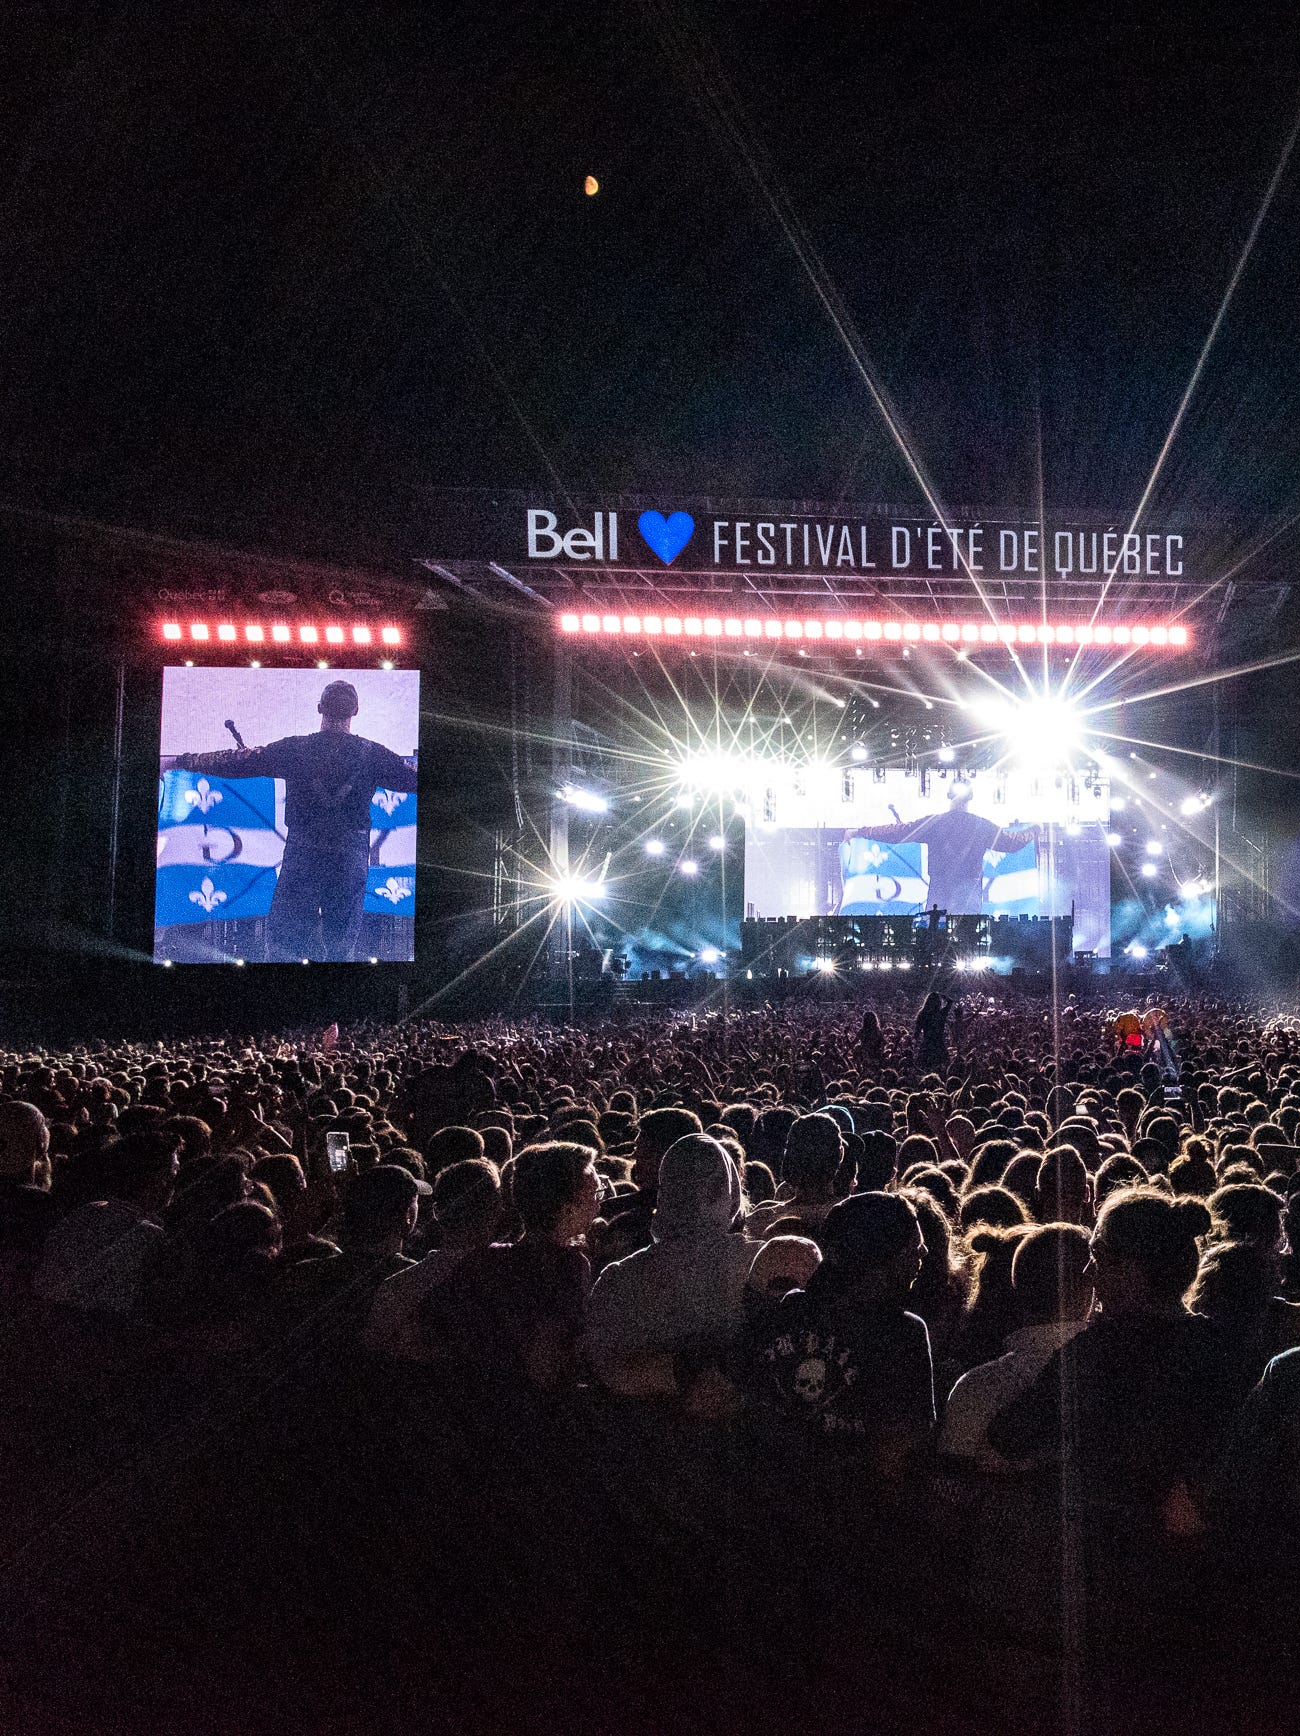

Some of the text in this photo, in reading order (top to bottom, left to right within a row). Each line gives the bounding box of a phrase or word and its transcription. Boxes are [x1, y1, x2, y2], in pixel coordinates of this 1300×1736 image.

[527, 509, 618, 560] Bell
[714, 521, 1183, 578] FESTIVAL D'ÉTÉ DE QUÉBEC
